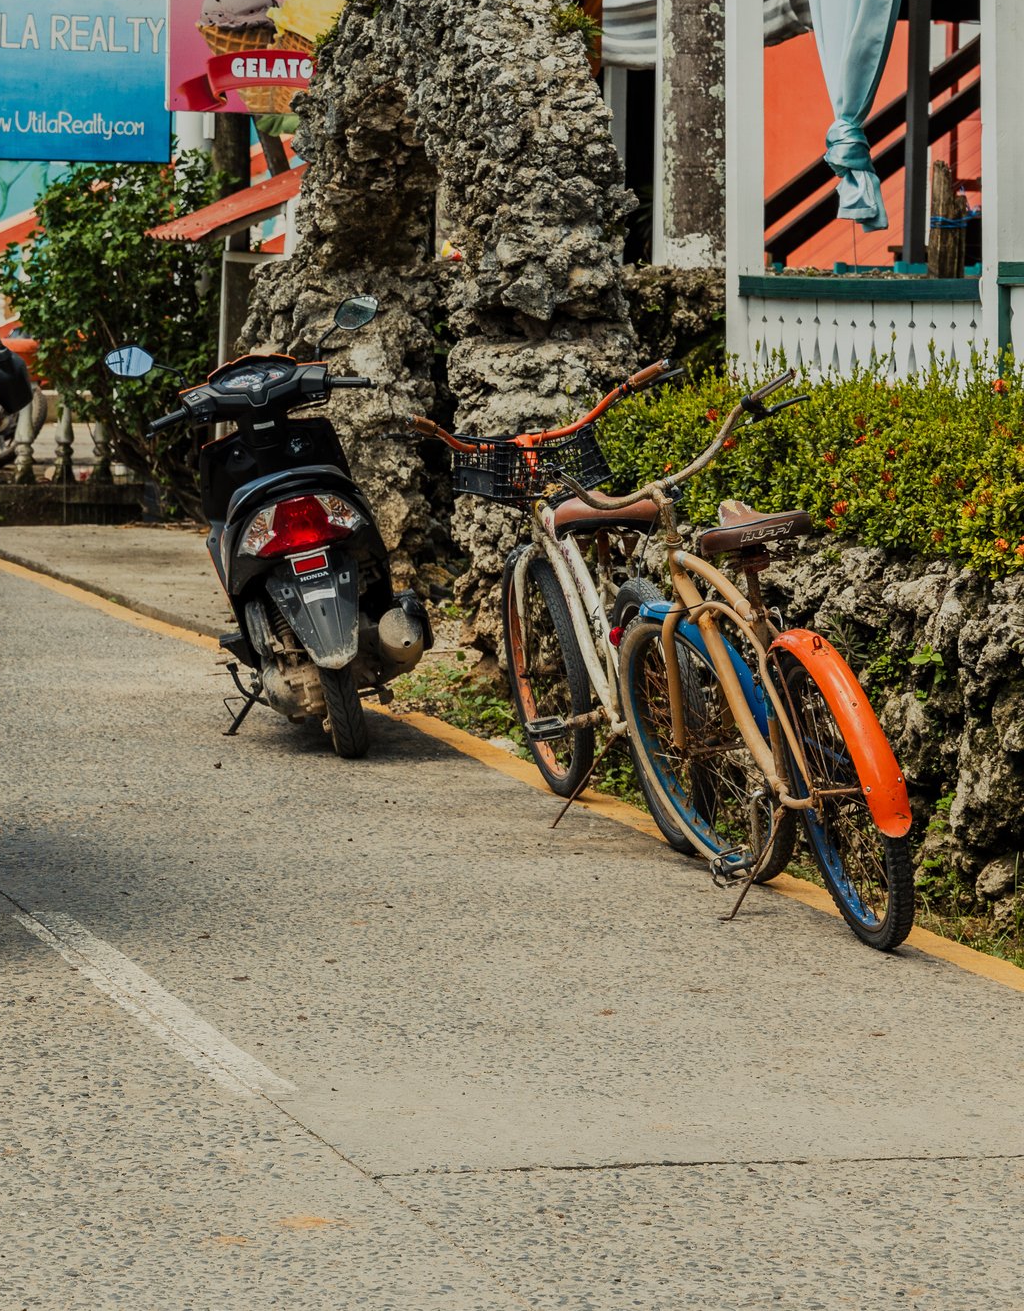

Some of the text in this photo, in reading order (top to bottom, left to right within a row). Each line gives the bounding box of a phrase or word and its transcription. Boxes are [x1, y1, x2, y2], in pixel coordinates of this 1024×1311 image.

[49, 13, 166, 54] REALTY
[230, 56, 314, 80] GELATO
[299, 570, 330, 583] HONDA
